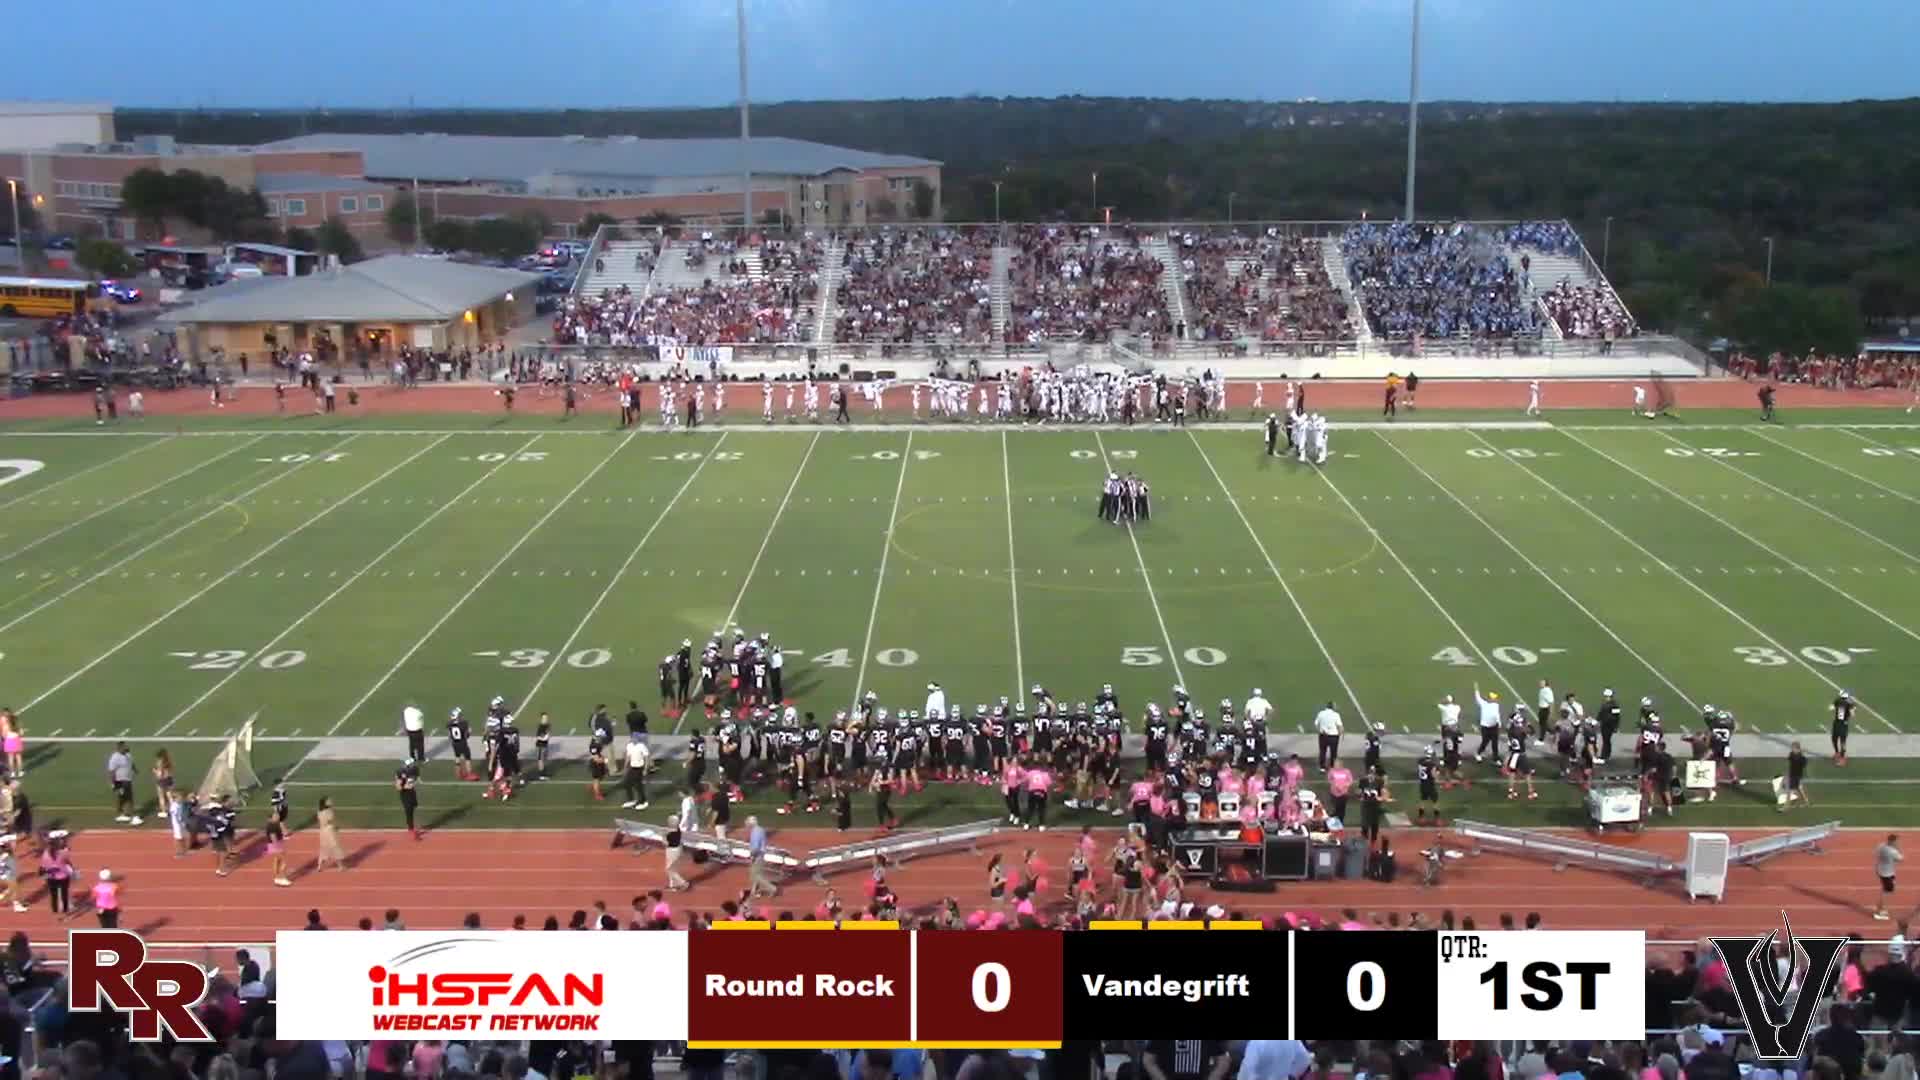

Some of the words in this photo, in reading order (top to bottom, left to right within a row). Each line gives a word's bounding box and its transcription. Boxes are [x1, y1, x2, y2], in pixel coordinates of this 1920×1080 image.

[188, 650, 306, 669] 20
[501, 648, 612, 668] 30
[810, 648, 919, 667] 40
[1121, 646, 1227, 666] 50
[1431, 646, 1538, 666] 40
[1733, 646, 1851, 666] 30
[730, 663, 739, 676] 11
[872, 729, 888, 743] 32
[947, 727, 963, 740] 90
[1643, 730, 1659, 744] 94
[1245, 738, 1256, 750] 4
